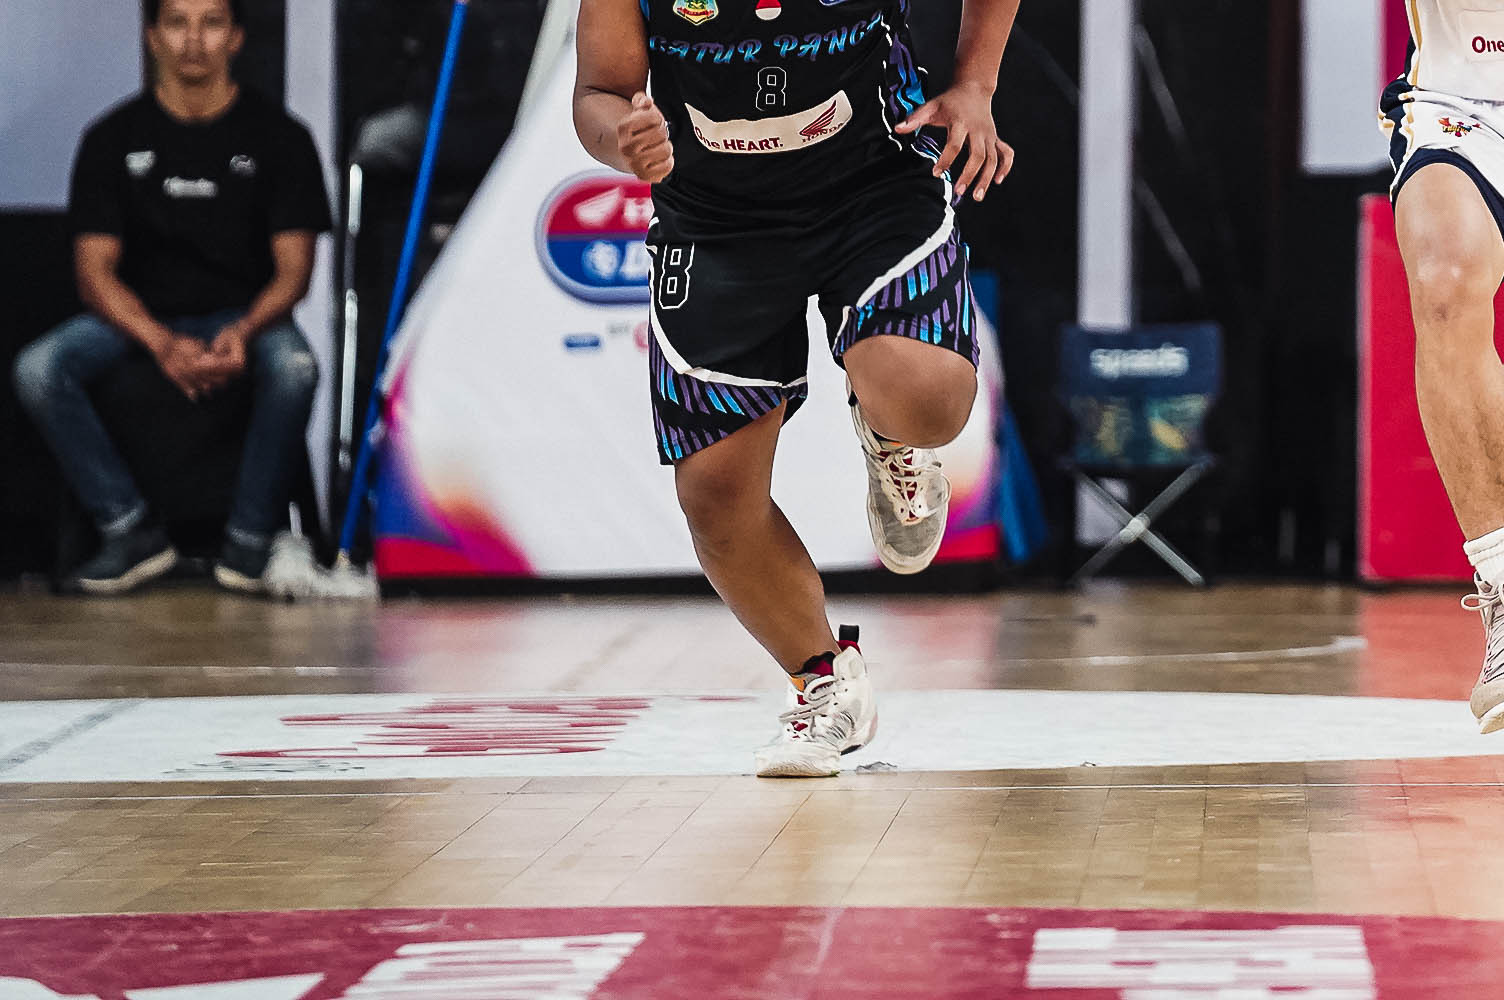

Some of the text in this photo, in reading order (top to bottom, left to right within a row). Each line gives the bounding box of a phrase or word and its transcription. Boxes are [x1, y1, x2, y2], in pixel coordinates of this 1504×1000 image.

[1472, 34, 1504, 54] One
[755, 66, 787, 111] 8
[694, 126, 783, 151] One HEART.
[658, 242, 695, 309] 8
